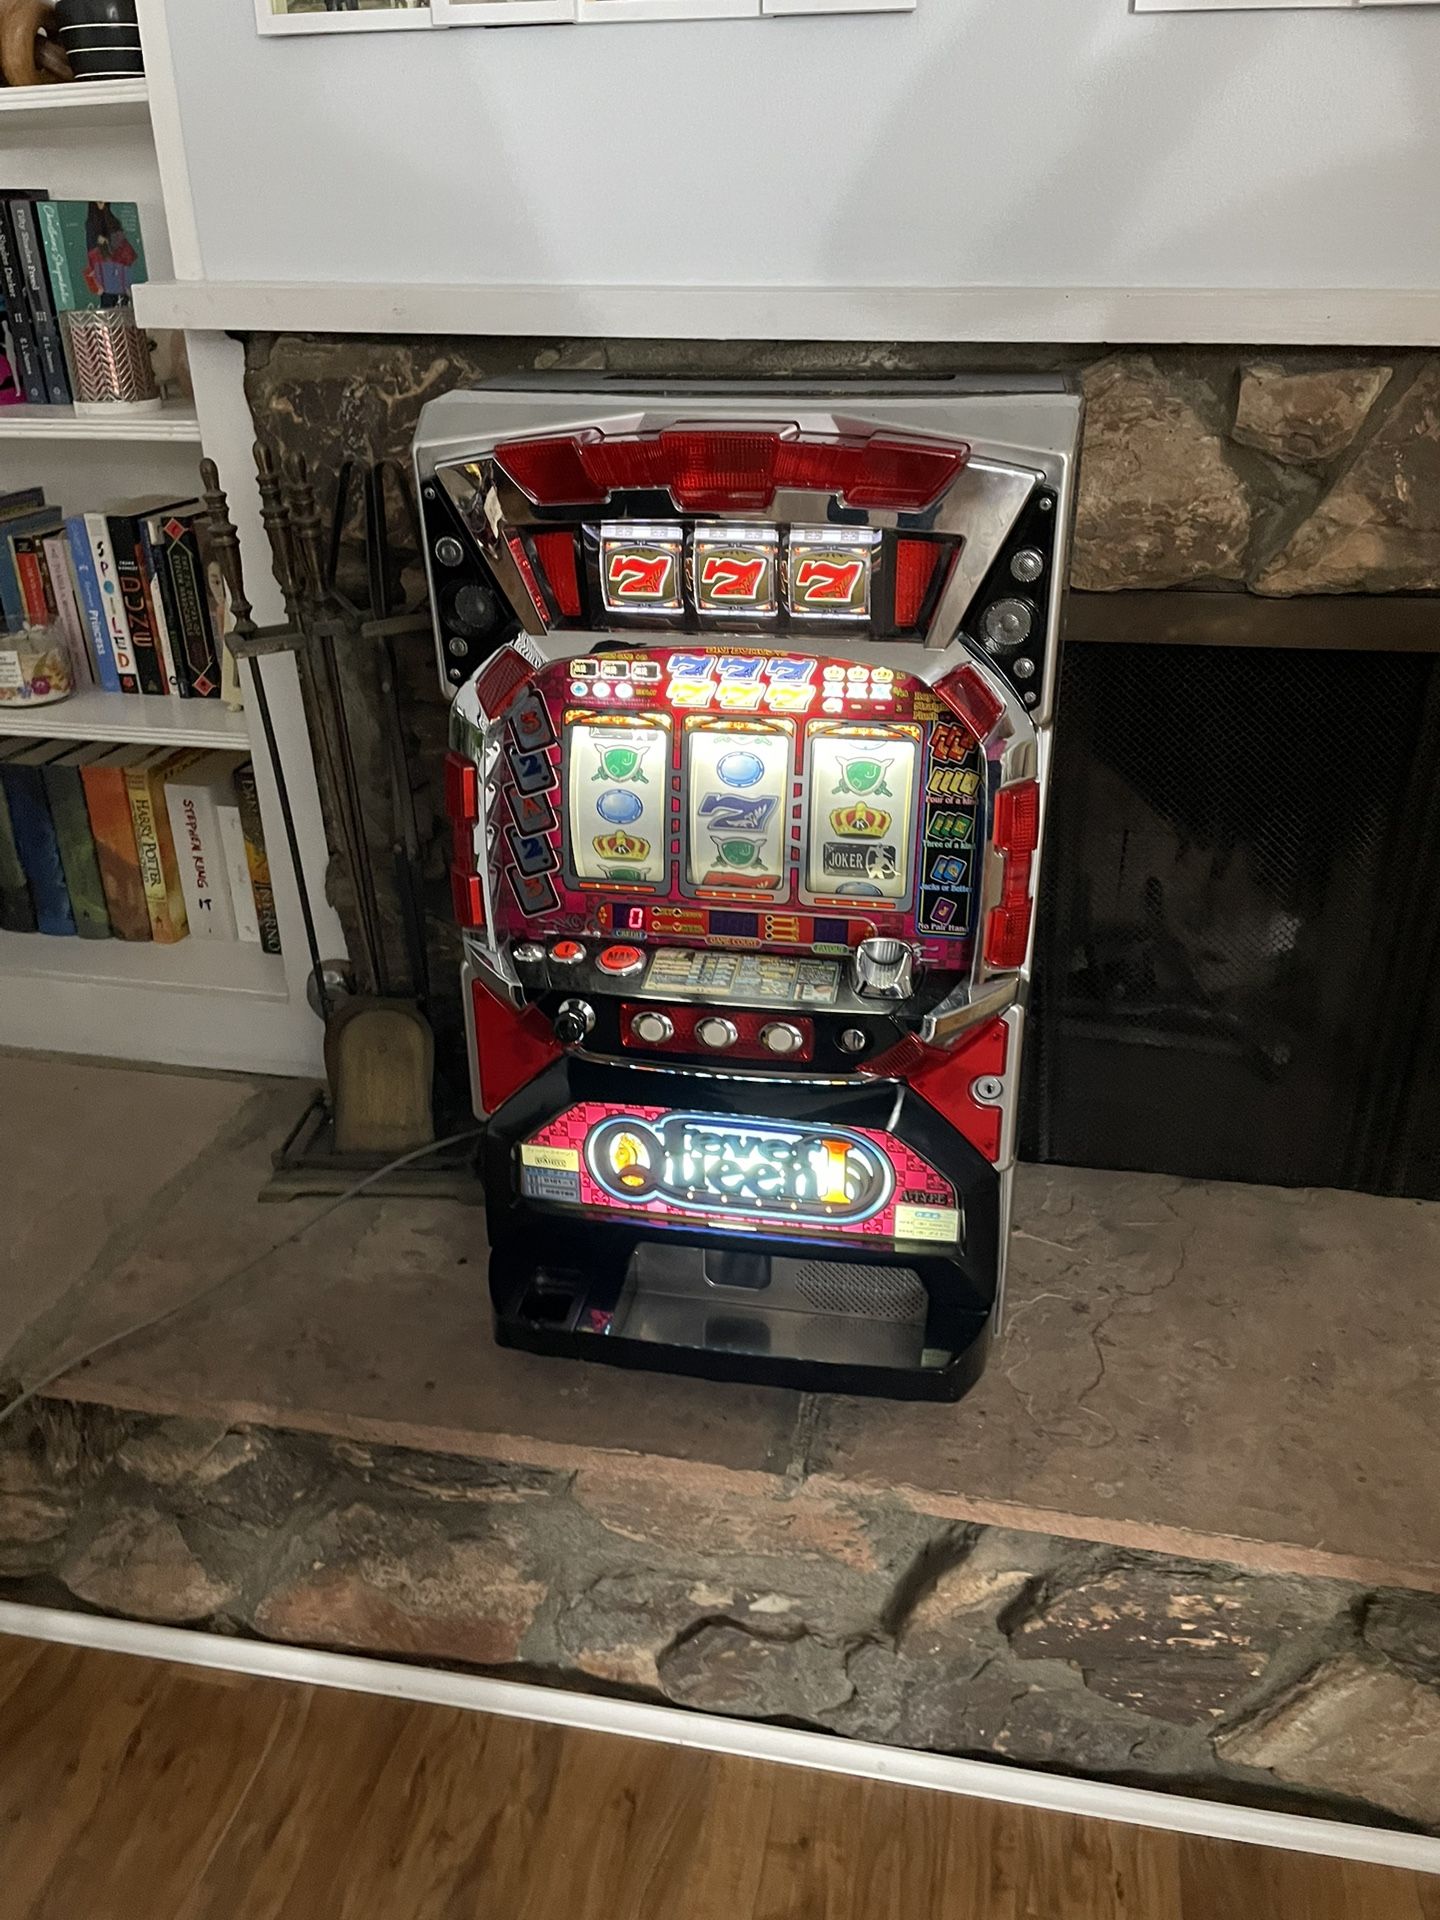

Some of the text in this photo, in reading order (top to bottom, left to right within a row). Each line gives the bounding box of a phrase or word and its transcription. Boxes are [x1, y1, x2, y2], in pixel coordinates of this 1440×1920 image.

[4, 266, 17, 298] Darker
[28, 264, 41, 292] Freed
[609, 554, 864, 602] 7 7 7
[88, 609, 106, 655] Princess
[120, 576, 153, 648] DUNE
[136, 799, 155, 841] HARRY
[142, 841, 162, 887] POTTER
[183, 799, 212, 911] STEPHEN KING IT
[828, 852, 864, 869] JOKER
[628, 907, 644, 929] 0
[606, 951, 632, 961] MAX
